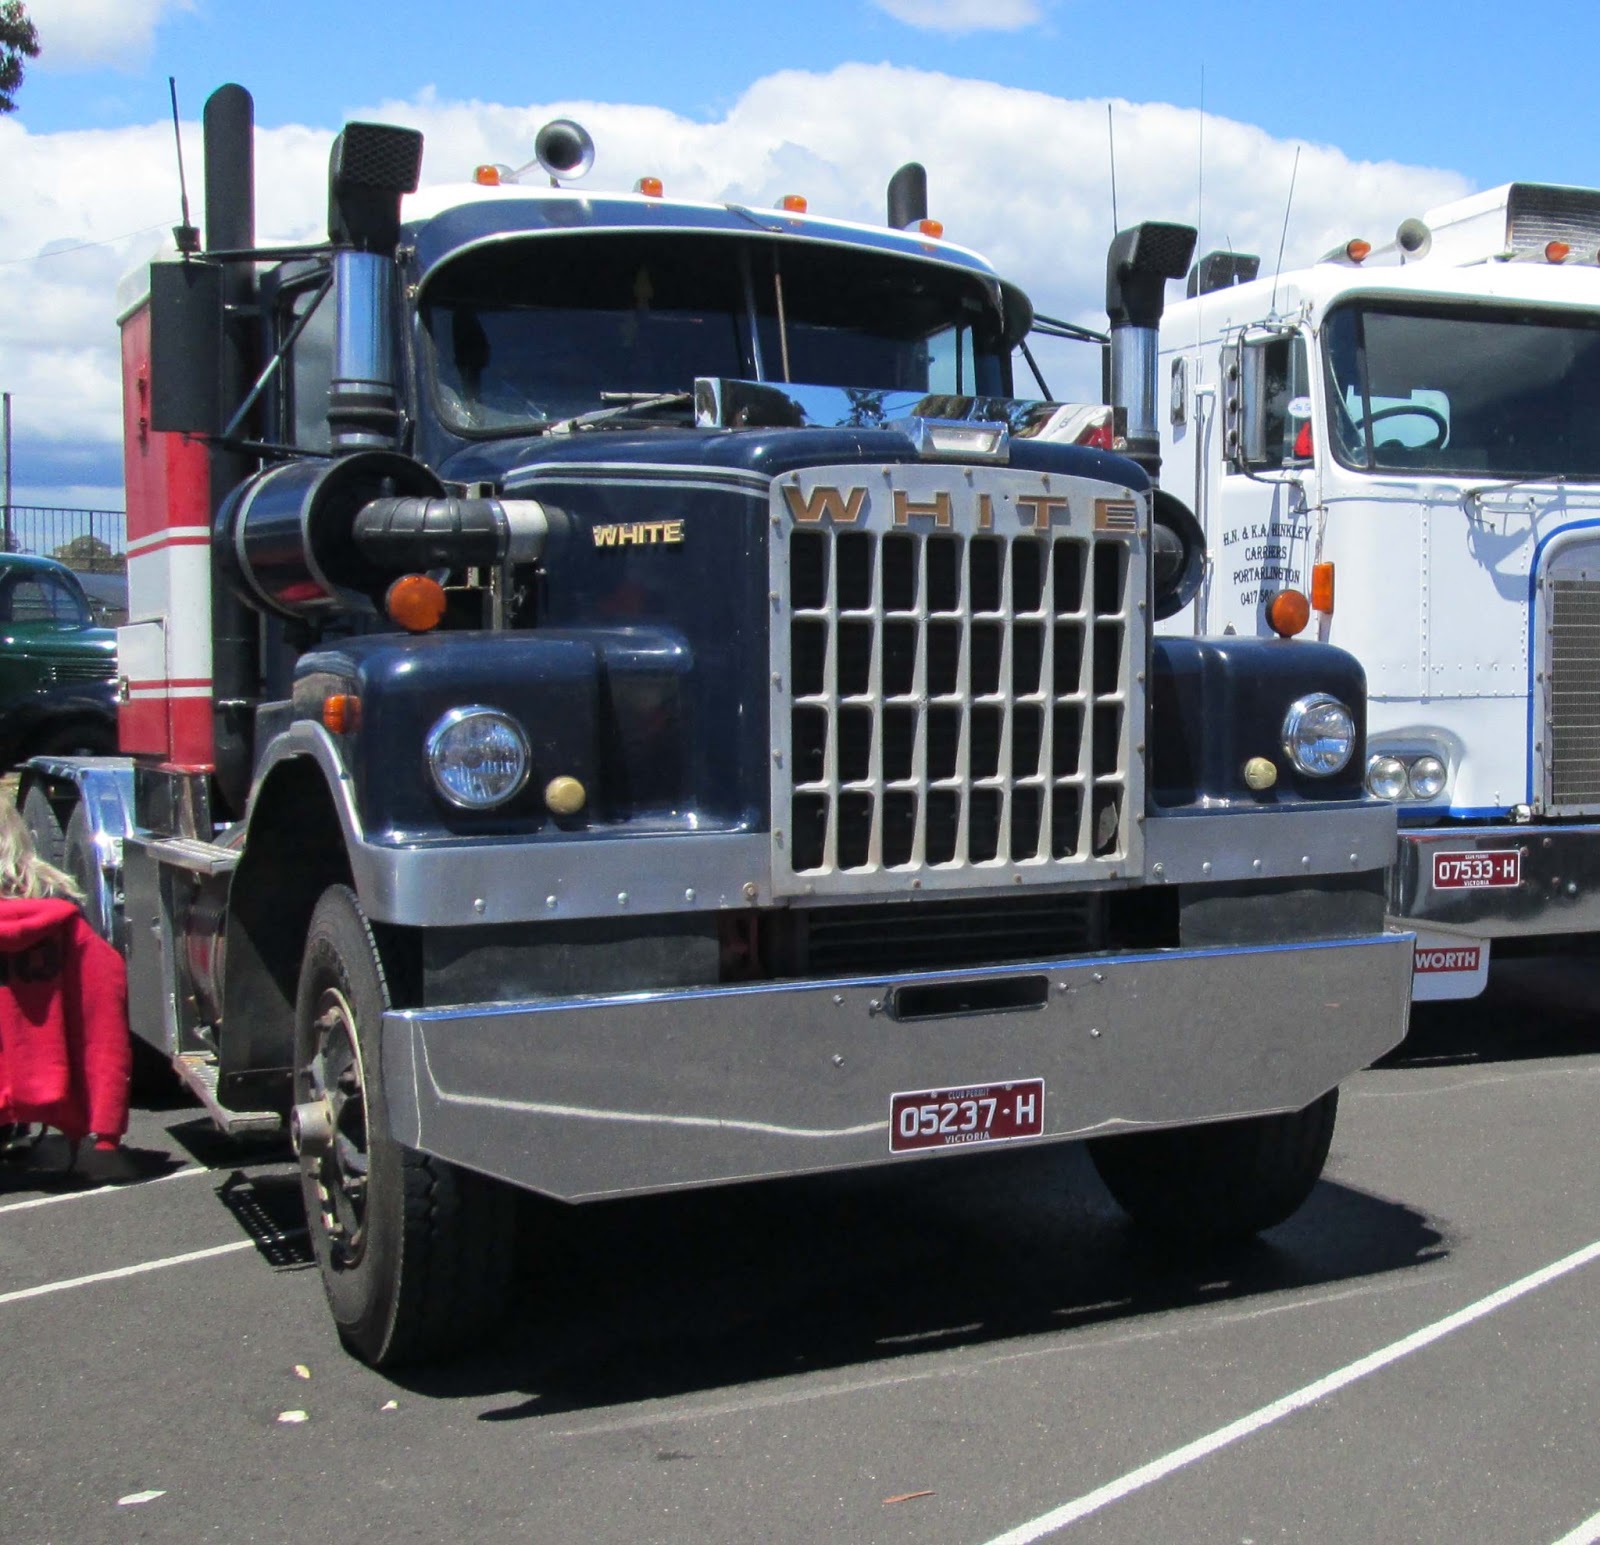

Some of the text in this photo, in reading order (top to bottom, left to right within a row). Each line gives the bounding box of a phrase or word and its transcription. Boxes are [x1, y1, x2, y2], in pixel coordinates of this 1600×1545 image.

[780, 484, 1137, 533] WHITE
[592, 519, 684, 547] WHITE
[1271, 523, 1312, 541] HINKLEY
[1245, 545, 1287, 561] CARRIERS
[1233, 566, 1301, 585] PORTARLINGTON
[1240, 590, 1258, 606] 0417
[1415, 951, 1476, 969] WORTH
[945, 1131, 990, 1144] VICTORIA
